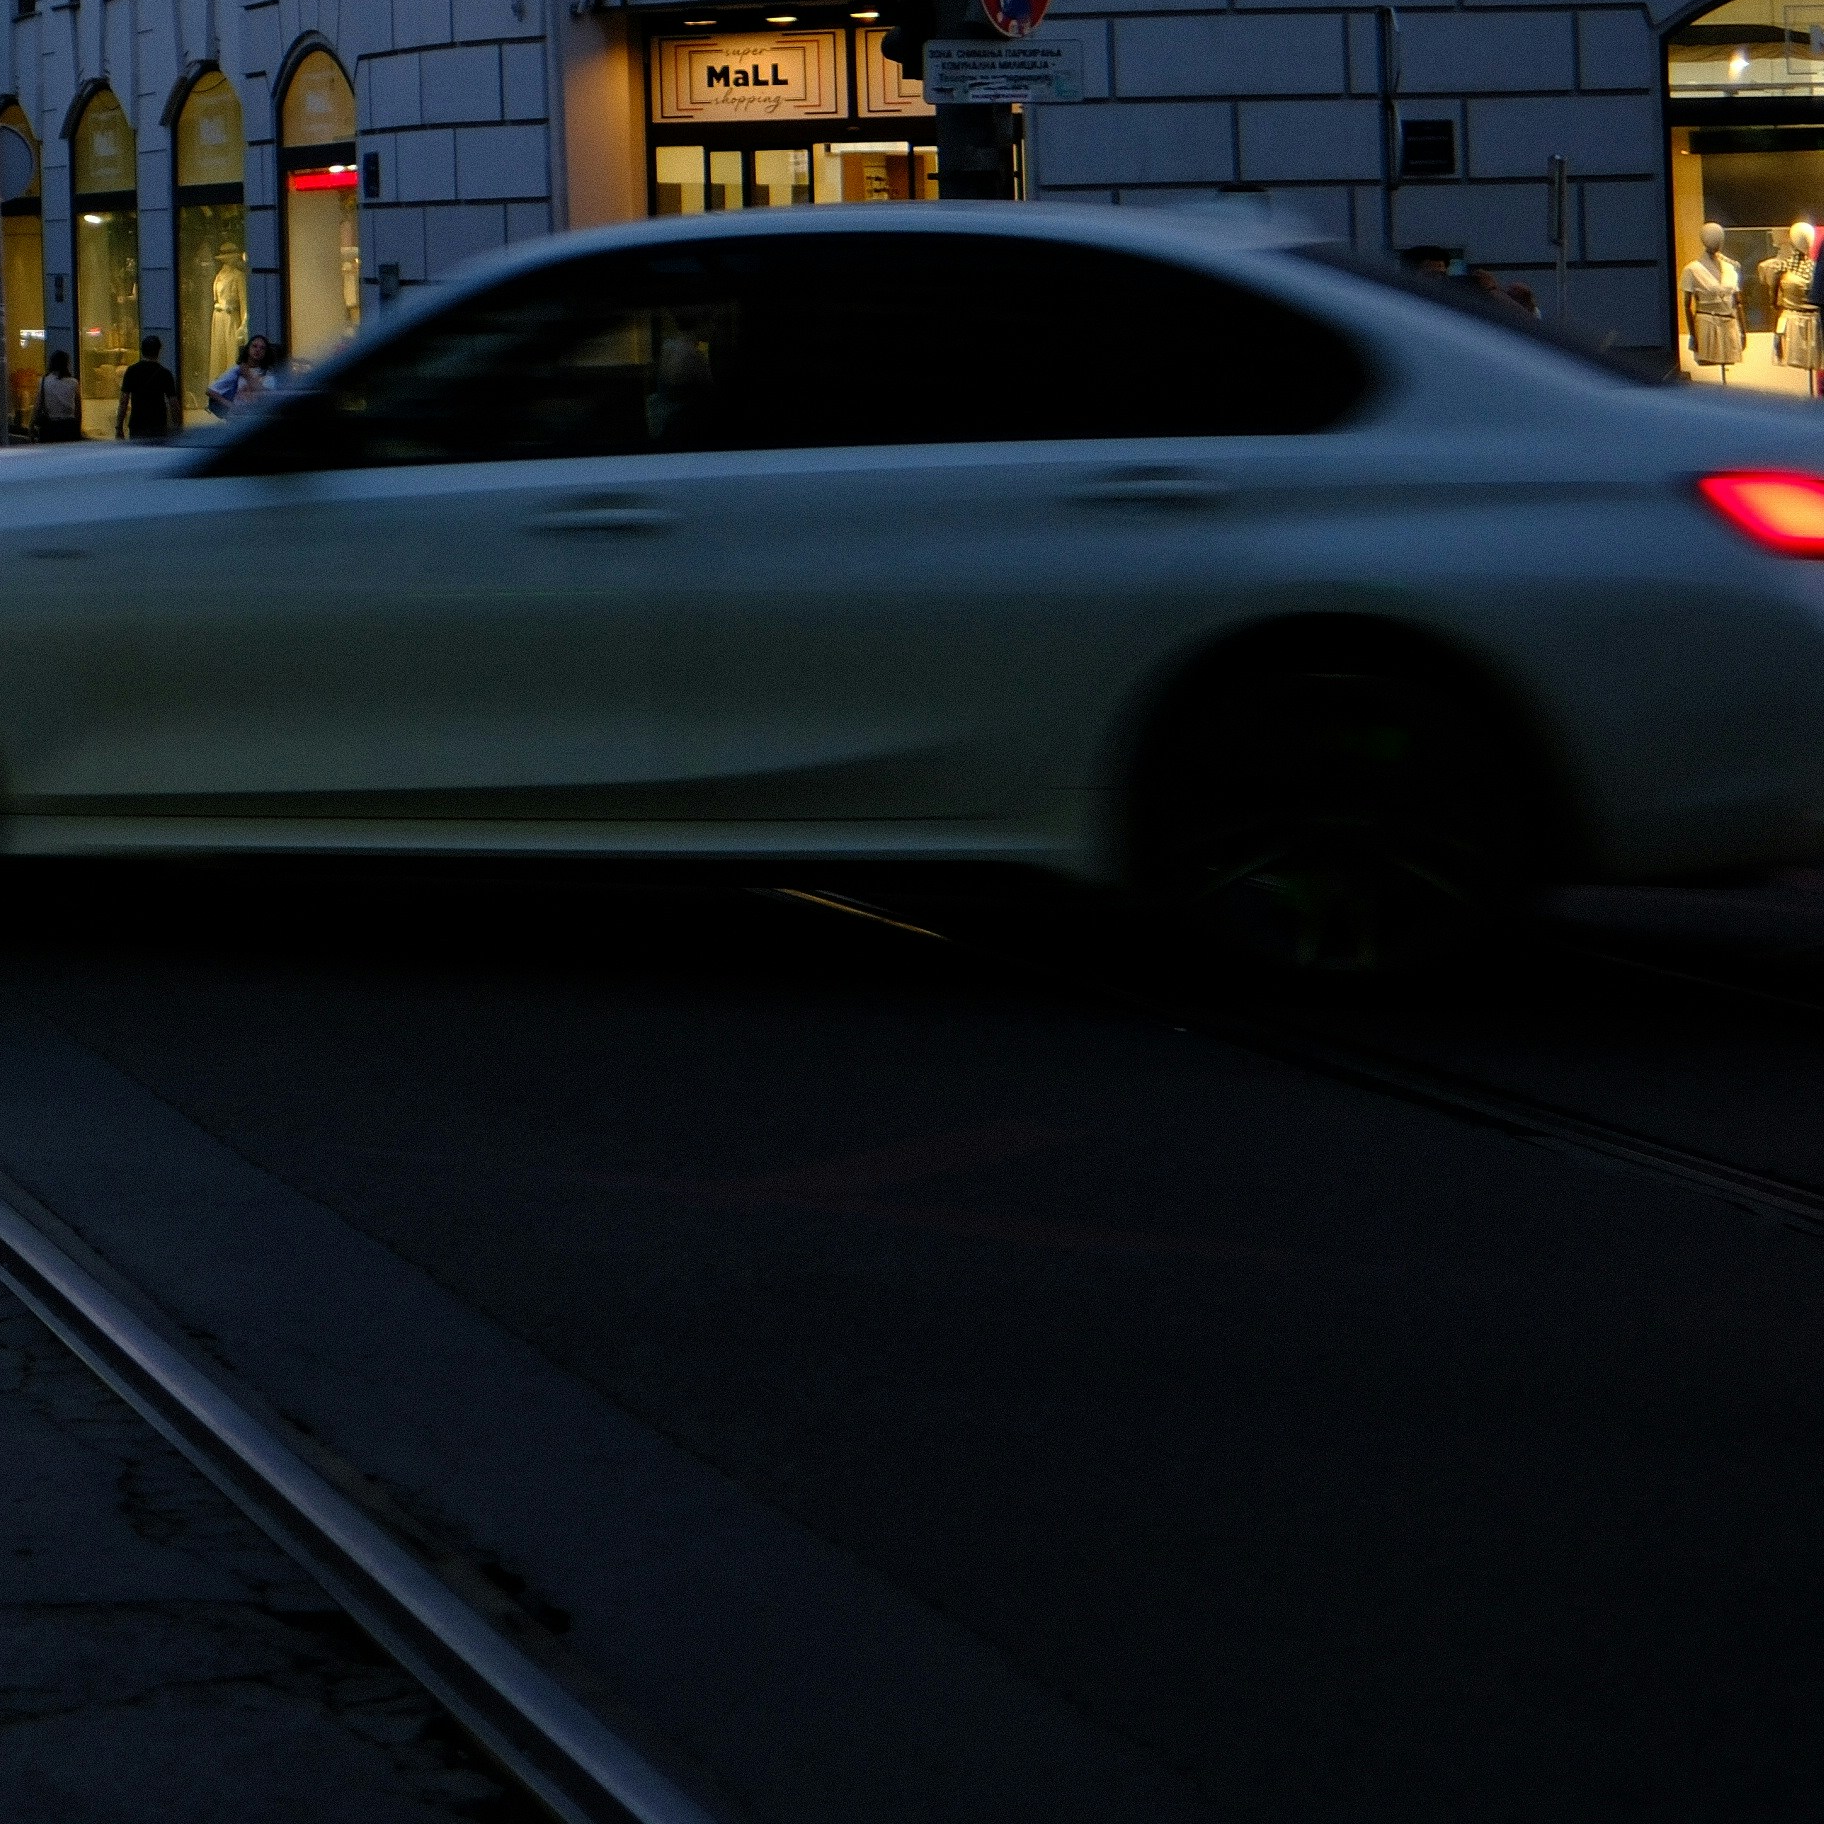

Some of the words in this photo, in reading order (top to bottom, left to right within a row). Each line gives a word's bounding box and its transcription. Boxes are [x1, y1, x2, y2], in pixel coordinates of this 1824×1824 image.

[723, 47, 767, 62] super
[706, 63, 789, 87] MaLL
[714, 87, 783, 114] shopping
